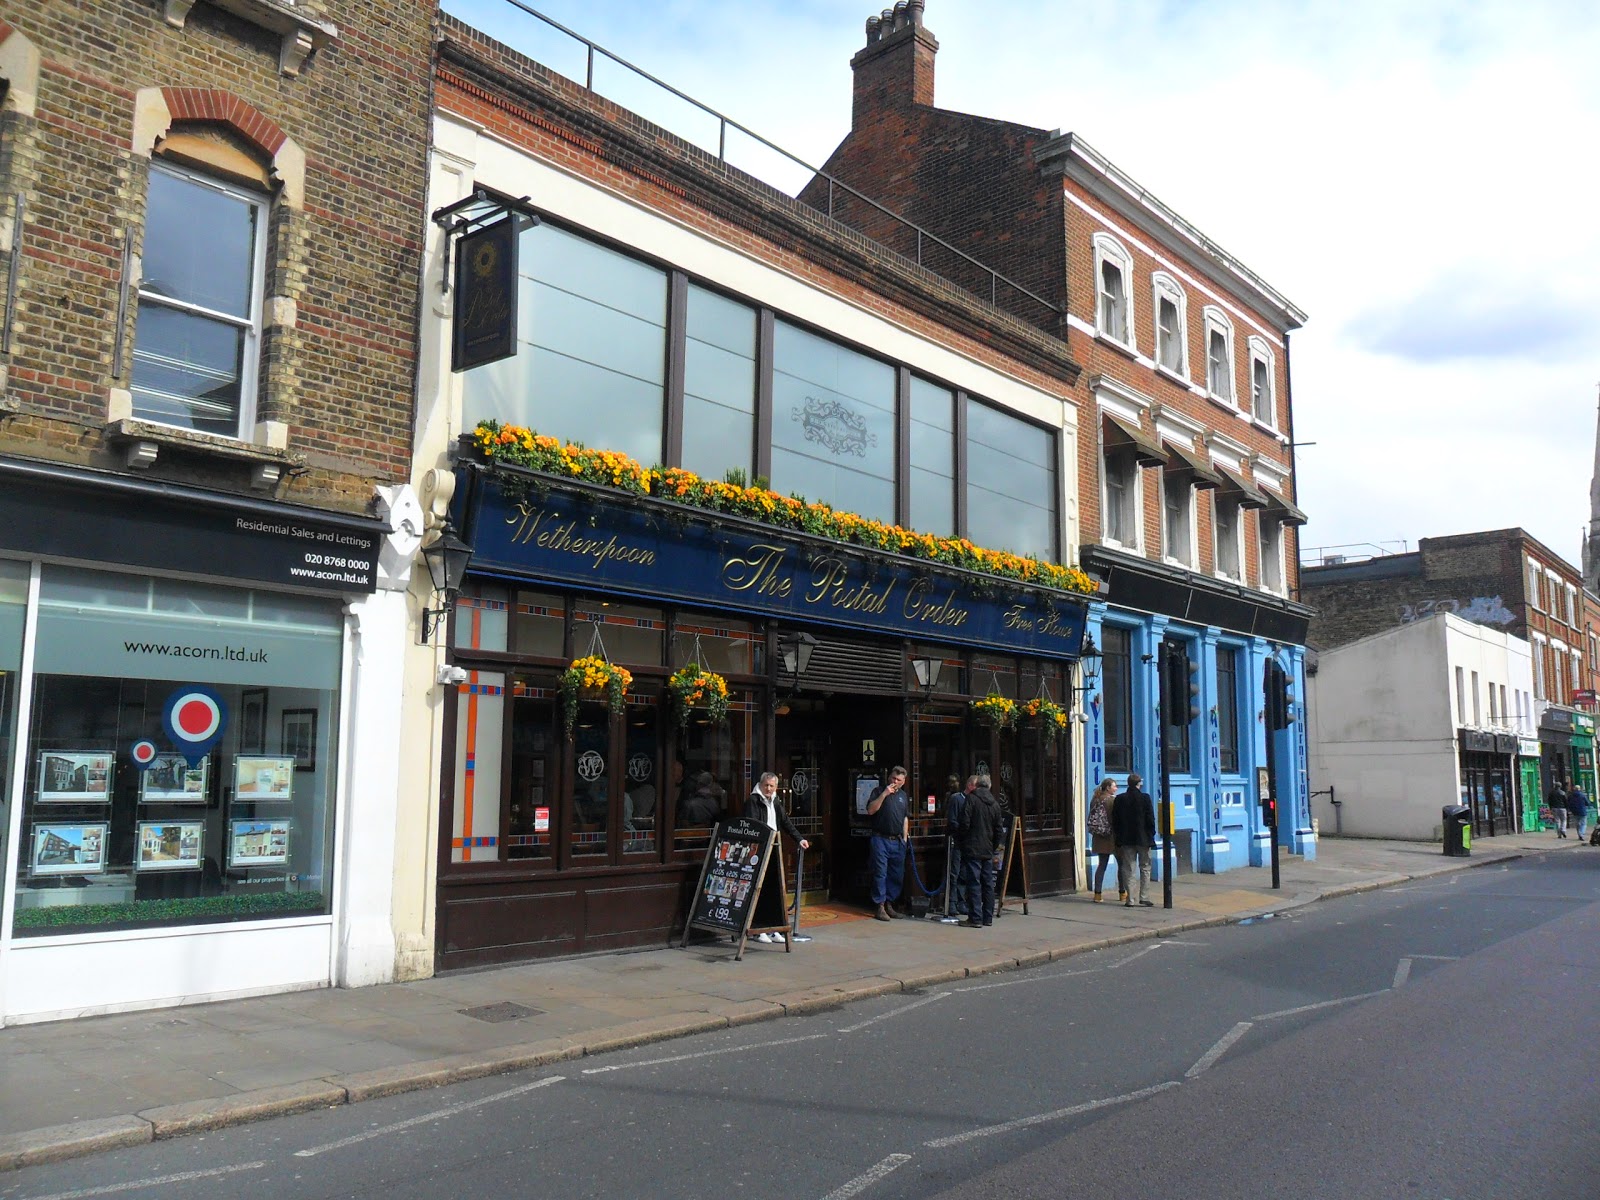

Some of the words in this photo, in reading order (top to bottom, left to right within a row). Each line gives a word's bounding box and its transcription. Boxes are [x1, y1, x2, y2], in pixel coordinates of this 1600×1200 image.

[236, 518, 289, 536] Residential
[291, 526, 315, 540] Sales
[317, 532, 334, 542] and
[336, 533, 372, 549] Lettings
[505, 500, 655, 568] Wetherspoon
[305, 553, 323, 565] 020
[324, 555, 346, 568] 8768
[348, 559, 370, 571] 0000
[290, 567, 369, 584] www.acorn.ltd.uk
[722, 544, 791, 599] The
[805, 555, 897, 615] Postal
[903, 576, 968, 627] Order
[1002, 604, 1033, 630] Free
[1037, 606, 1073, 638] House
[124, 641, 268, 663] www.acorn.ltd.uk
[727, 825, 744, 835] Postal
[739, 819, 751, 828] The
